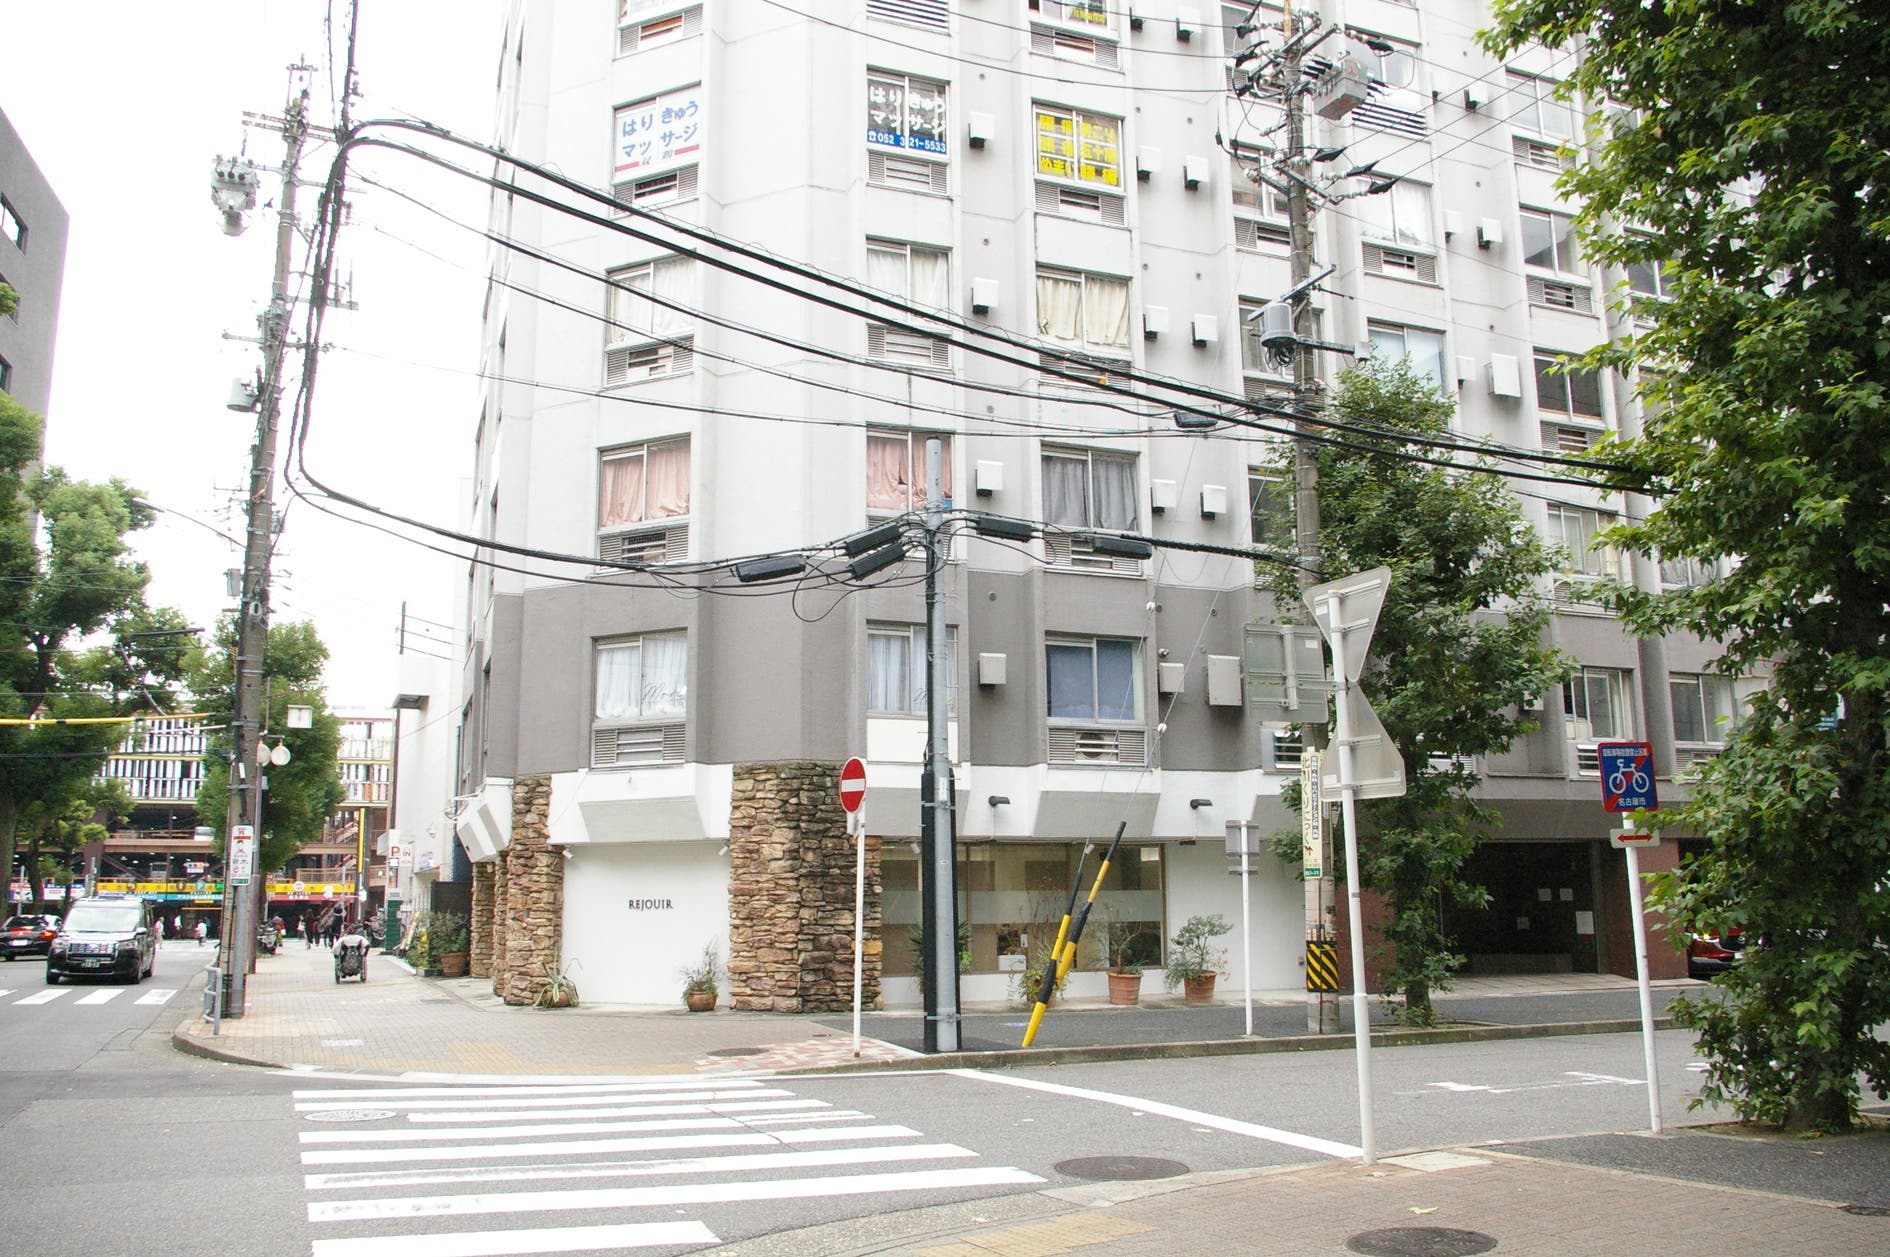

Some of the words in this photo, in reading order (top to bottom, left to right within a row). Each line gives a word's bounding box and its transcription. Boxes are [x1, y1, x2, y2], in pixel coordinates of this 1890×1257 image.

[869, 86, 903, 106] はり
[622, 113, 653, 137] はり
[661, 100, 698, 124] きゅう
[877, 132, 895, 145] 052
[1619, 797, 1646, 807] 名古屋市
[628, 899, 674, 911] REJOUIR
